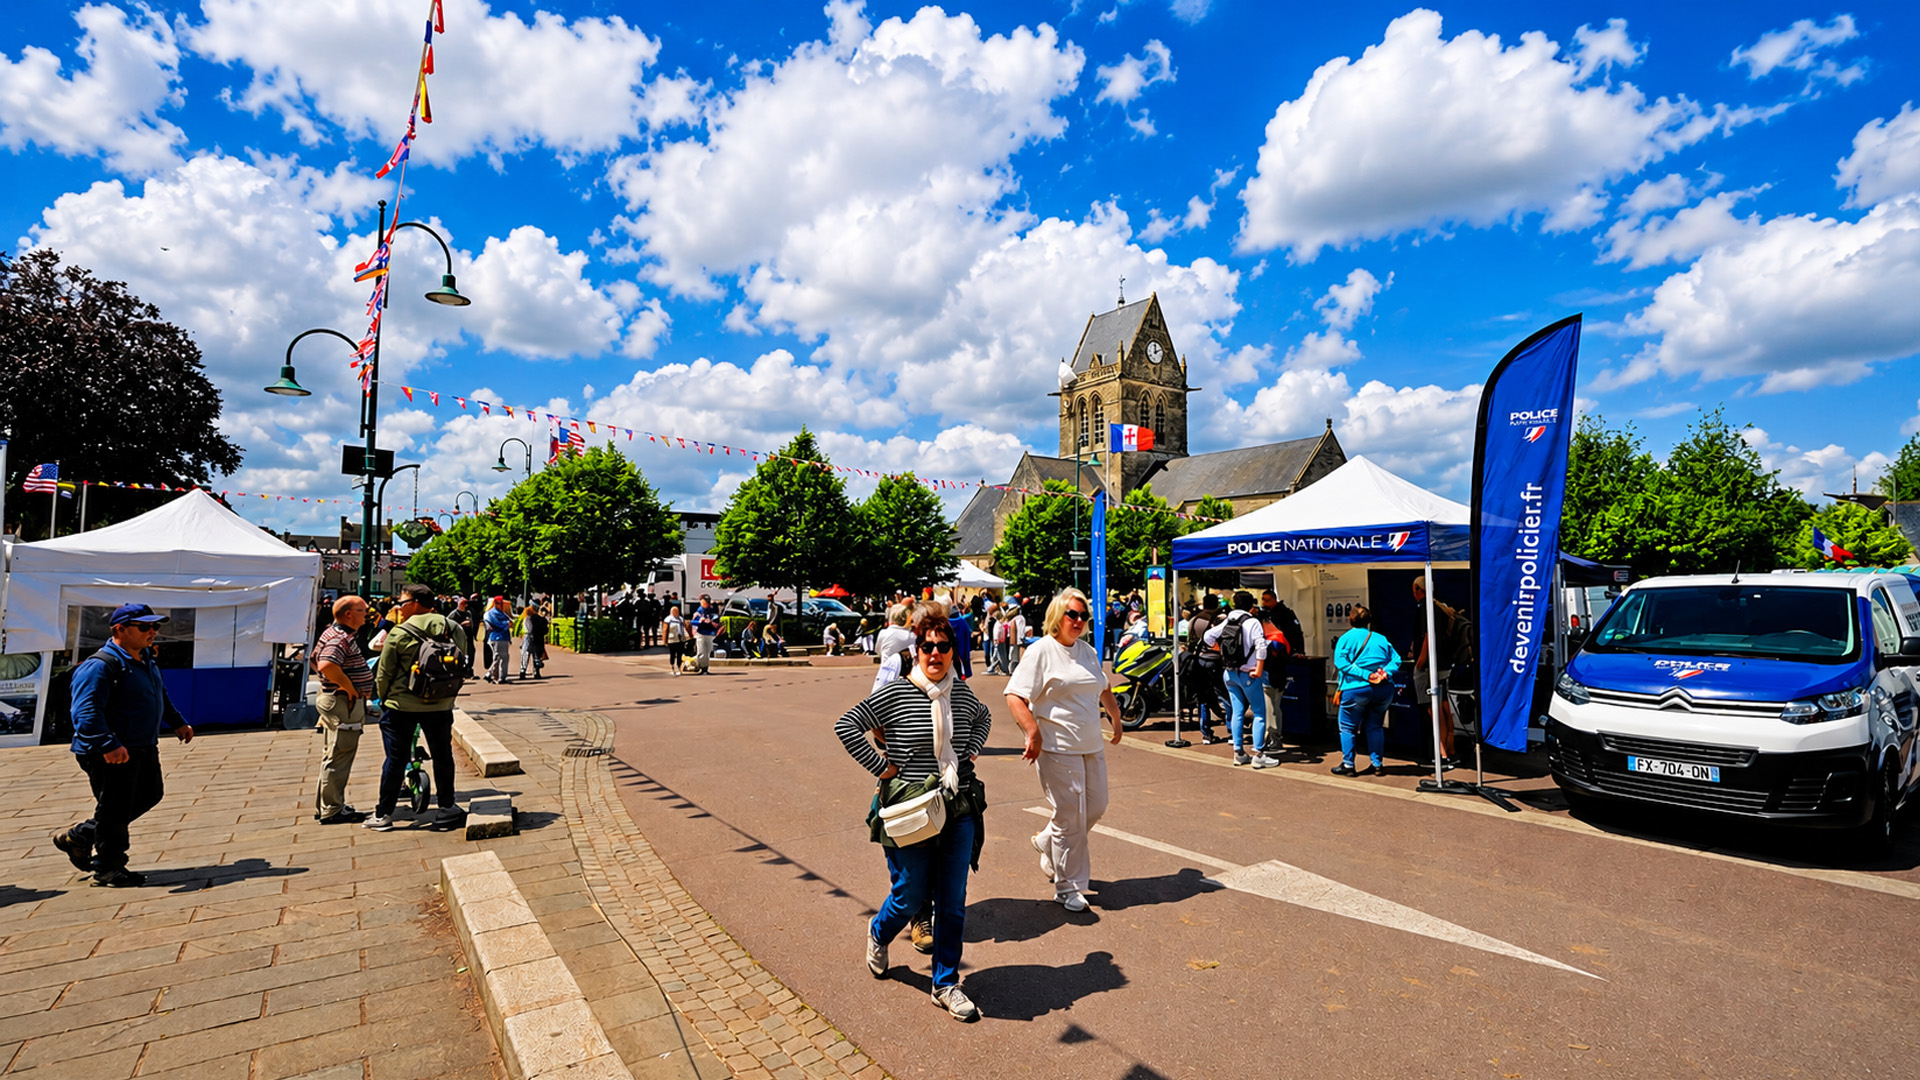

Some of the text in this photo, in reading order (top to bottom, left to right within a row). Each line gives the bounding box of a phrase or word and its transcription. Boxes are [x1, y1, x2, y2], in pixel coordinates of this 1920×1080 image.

[1510, 408, 1558, 421] POLICE
[1227, 534, 1382, 555] POLICE NATIONALE
[1509, 482, 1543, 674] devenirpolicier.fr
